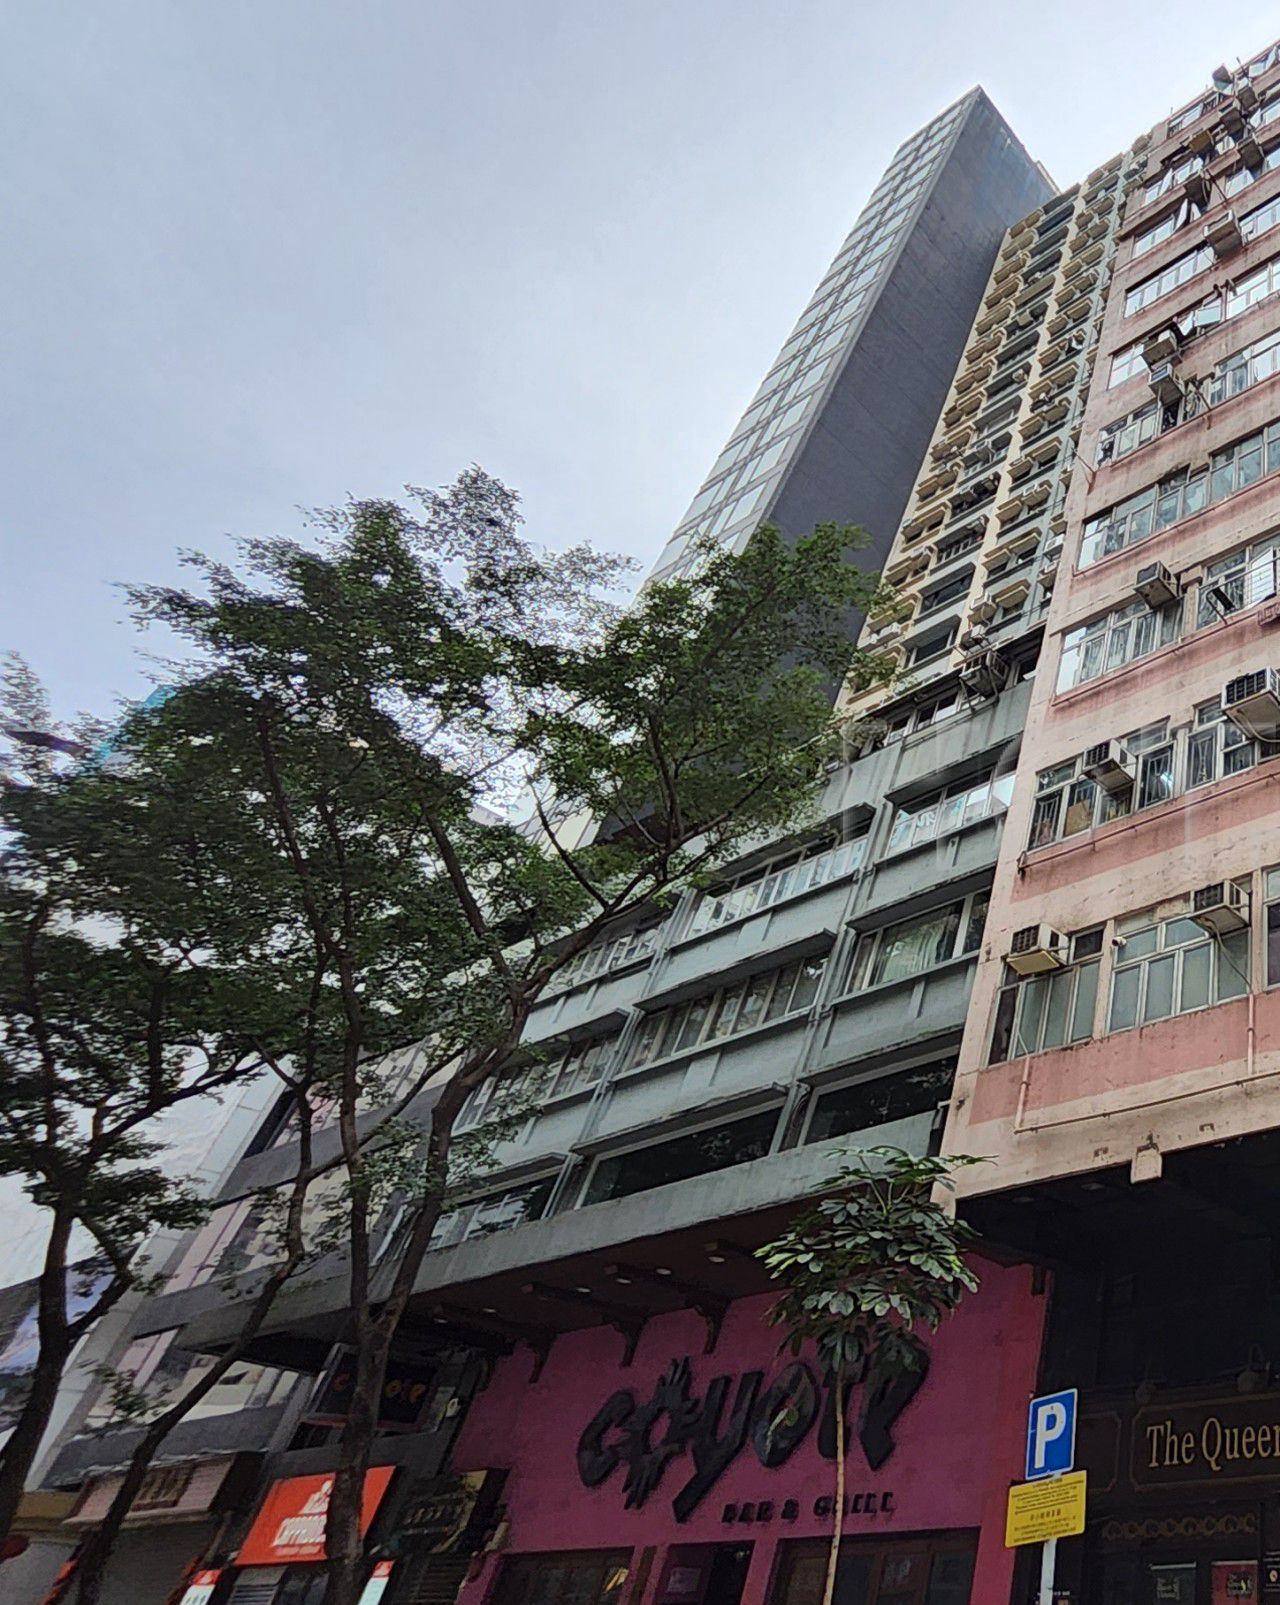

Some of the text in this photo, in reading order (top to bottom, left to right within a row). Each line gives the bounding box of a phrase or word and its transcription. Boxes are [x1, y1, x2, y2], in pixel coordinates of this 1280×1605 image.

[1034, 1401, 1067, 1470] P
[1146, 1420, 1195, 1468] The
[721, 1500, 774, 1523] BAR
